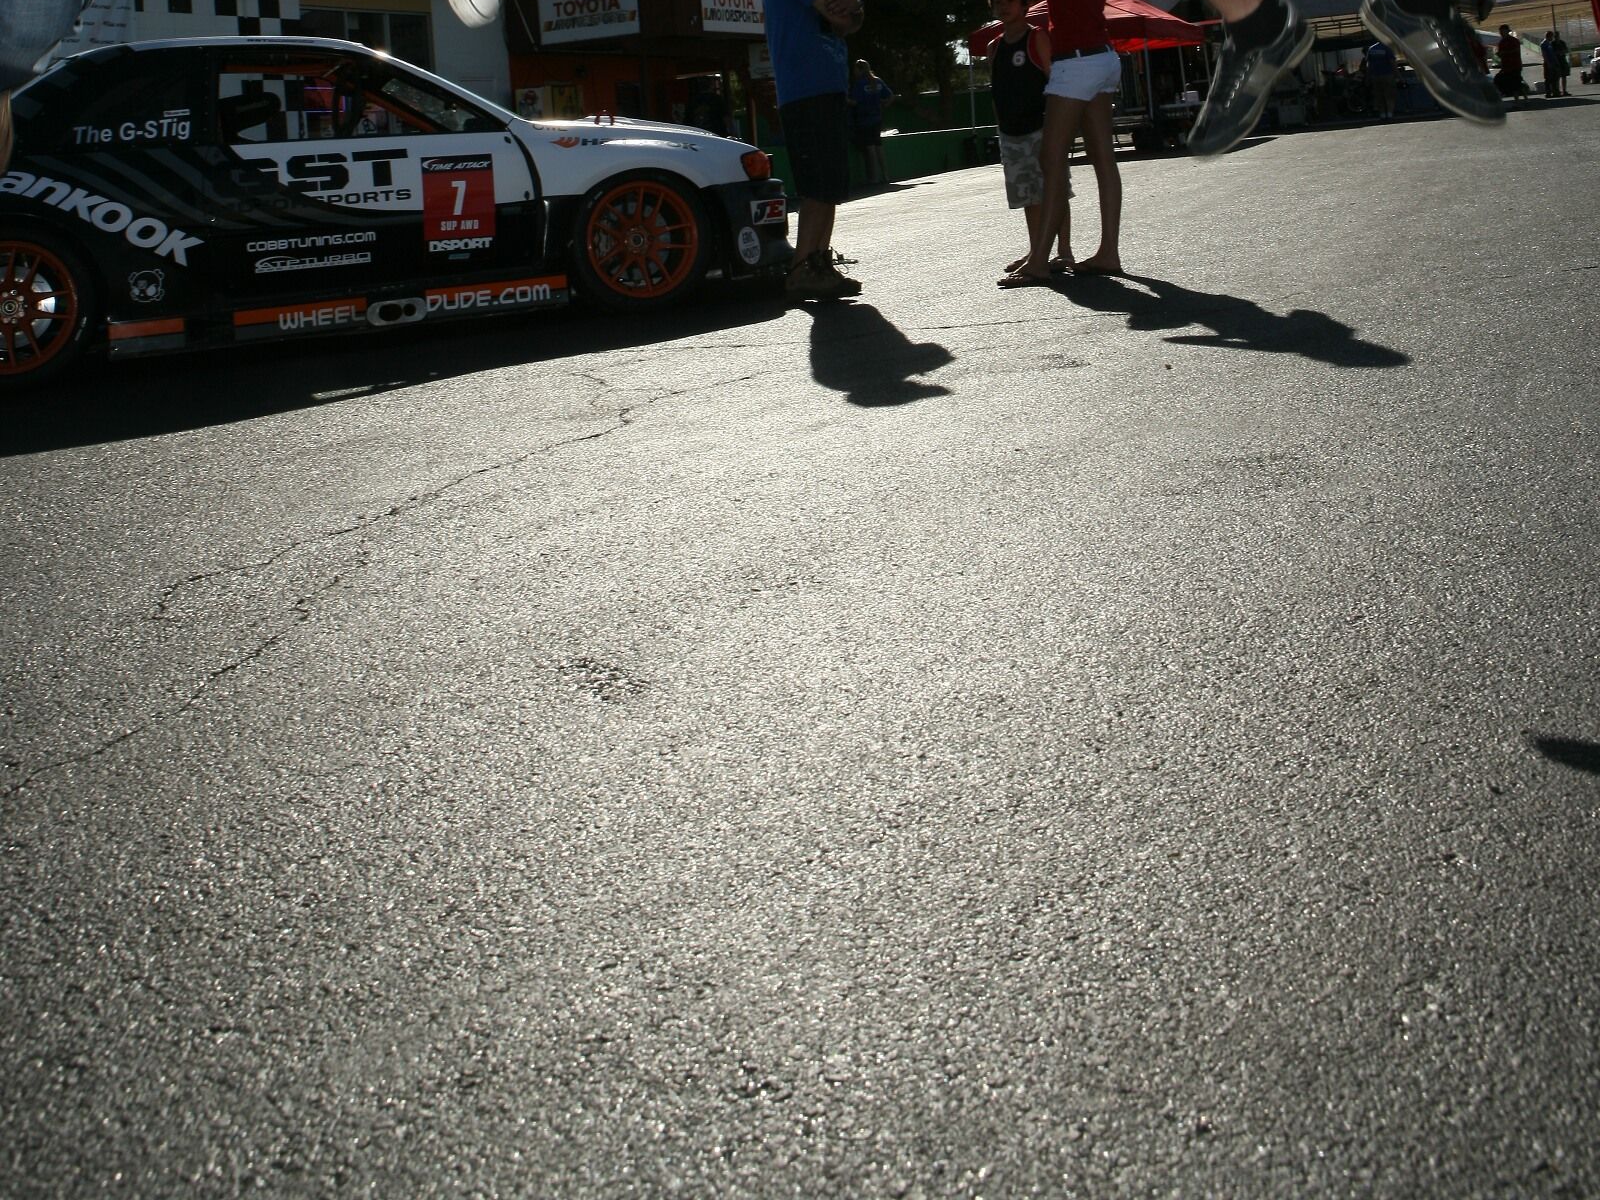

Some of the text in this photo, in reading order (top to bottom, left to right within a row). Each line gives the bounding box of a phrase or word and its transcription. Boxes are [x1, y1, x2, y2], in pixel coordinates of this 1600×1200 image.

[1013, 50, 1026, 66] 6
[72, 118, 191, 145] The G-STig
[454, 161, 491, 170] ATTACK
[451, 180, 466, 215] 7
[440, 219, 479, 231] SUP AWD
[246, 231, 376, 252] COBBTUNING.COM
[429, 237, 493, 252] DSPORT
[279, 283, 551, 330] WHEEL DUDE.COM
